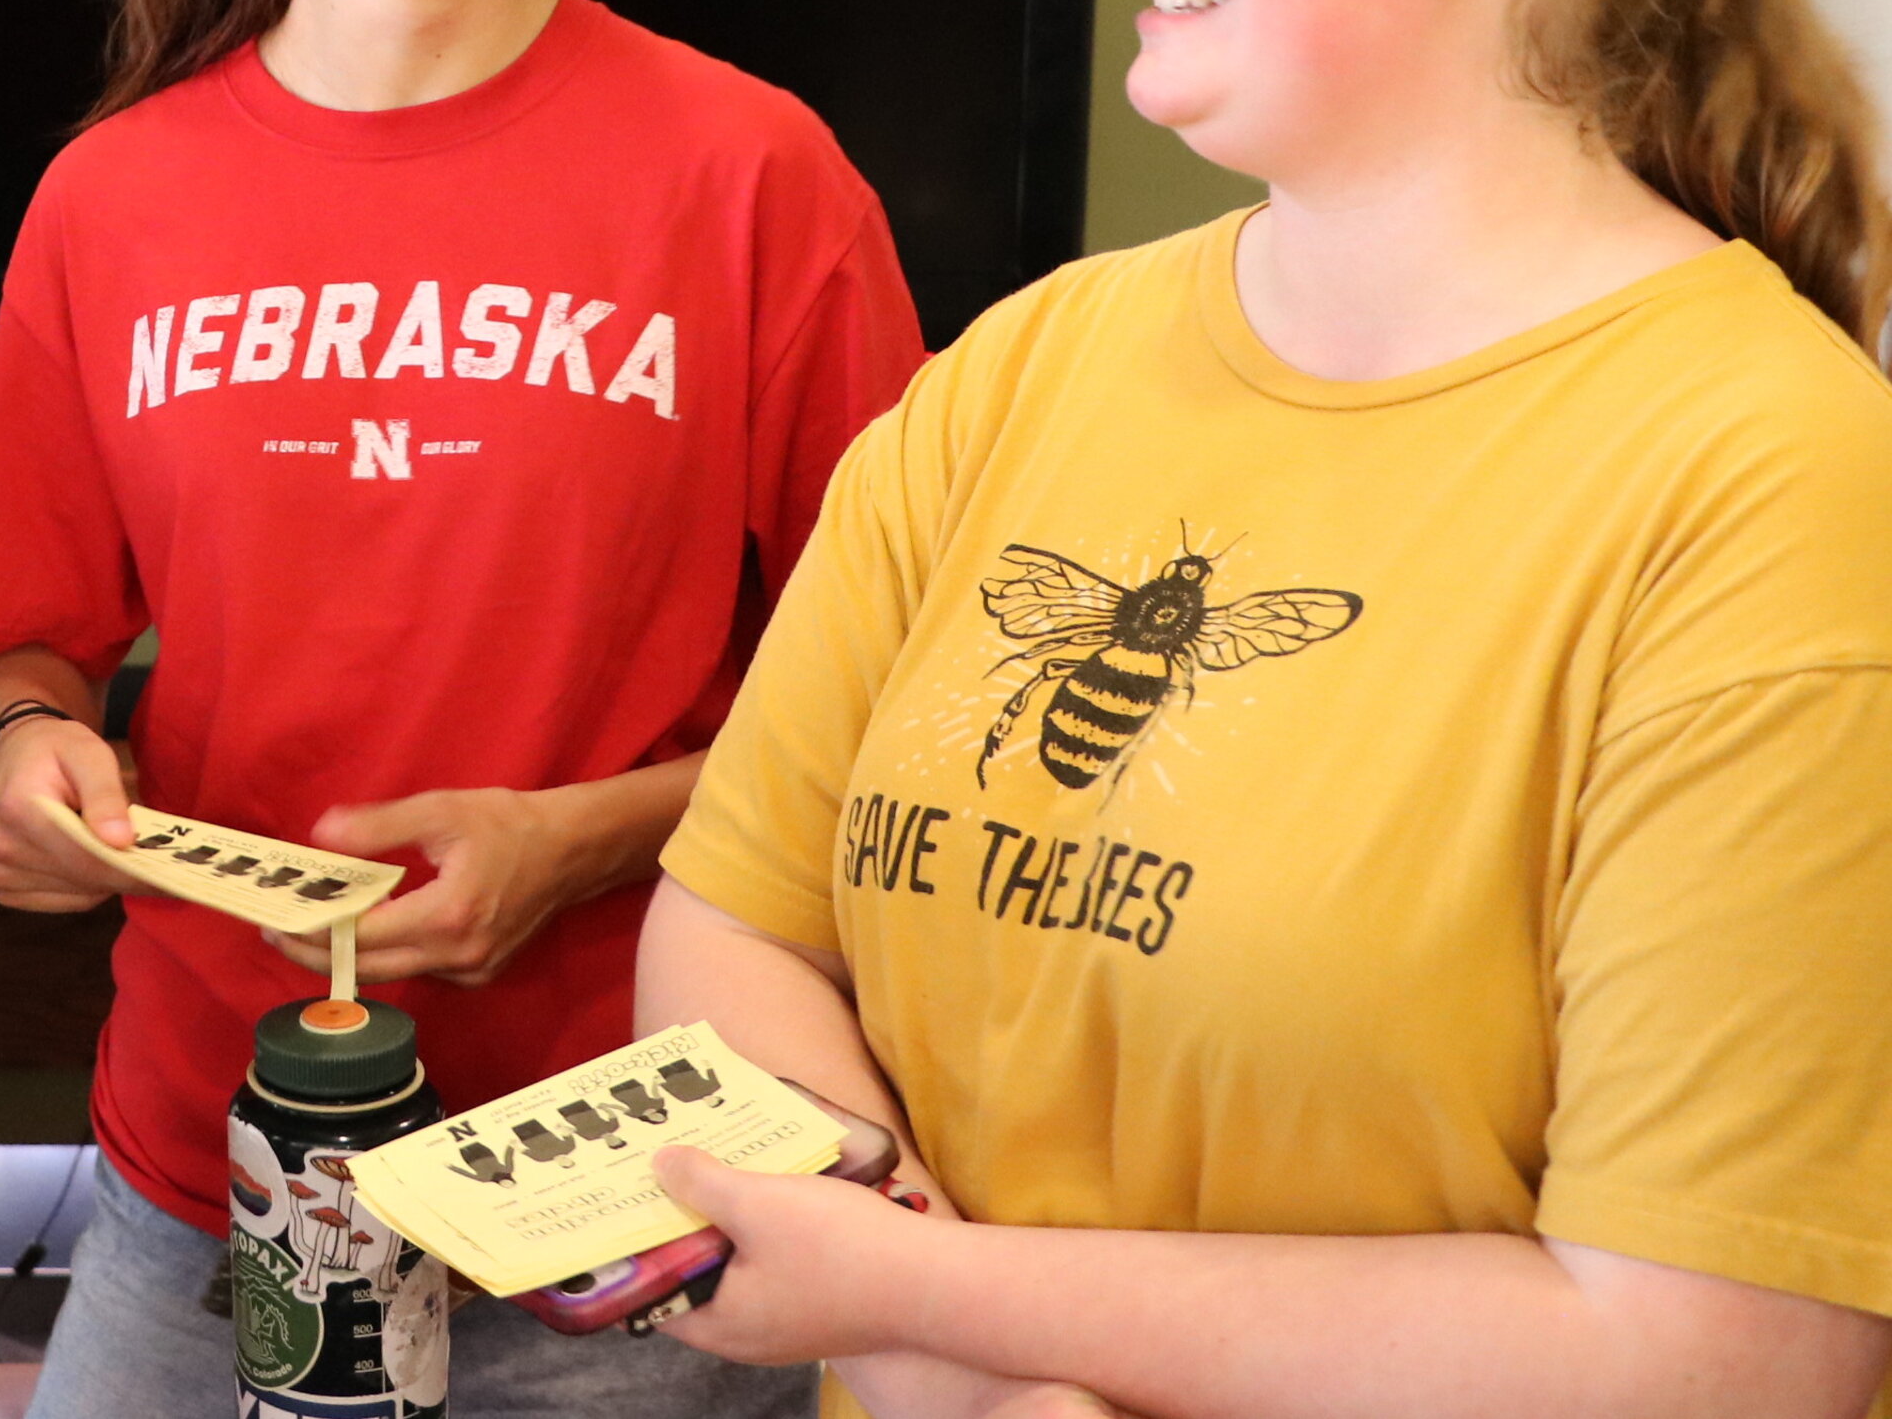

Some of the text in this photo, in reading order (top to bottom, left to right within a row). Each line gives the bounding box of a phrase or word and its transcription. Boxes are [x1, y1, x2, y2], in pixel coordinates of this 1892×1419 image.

[126, 280, 676, 420] NEBRASKA
[279, 440, 307, 453] OUR
[308, 441, 340, 455] GRIT
[351, 419, 411, 479] N
[420, 440, 482, 455] OUR GLORY
[167, 824, 193, 837] N
[844, 793, 950, 895] SAVE
[977, 820, 1080, 929] THE
[568, 1033, 700, 1094] Kick-off!
[446, 1120, 479, 1143] N
[719, 1121, 803, 1166] Hono
[352, 1290, 372, 1300] 600
[353, 1324, 373, 1334] 500
[252, 1363, 293, 1379] Colorado
[354, 1359, 374, 1369] 400
